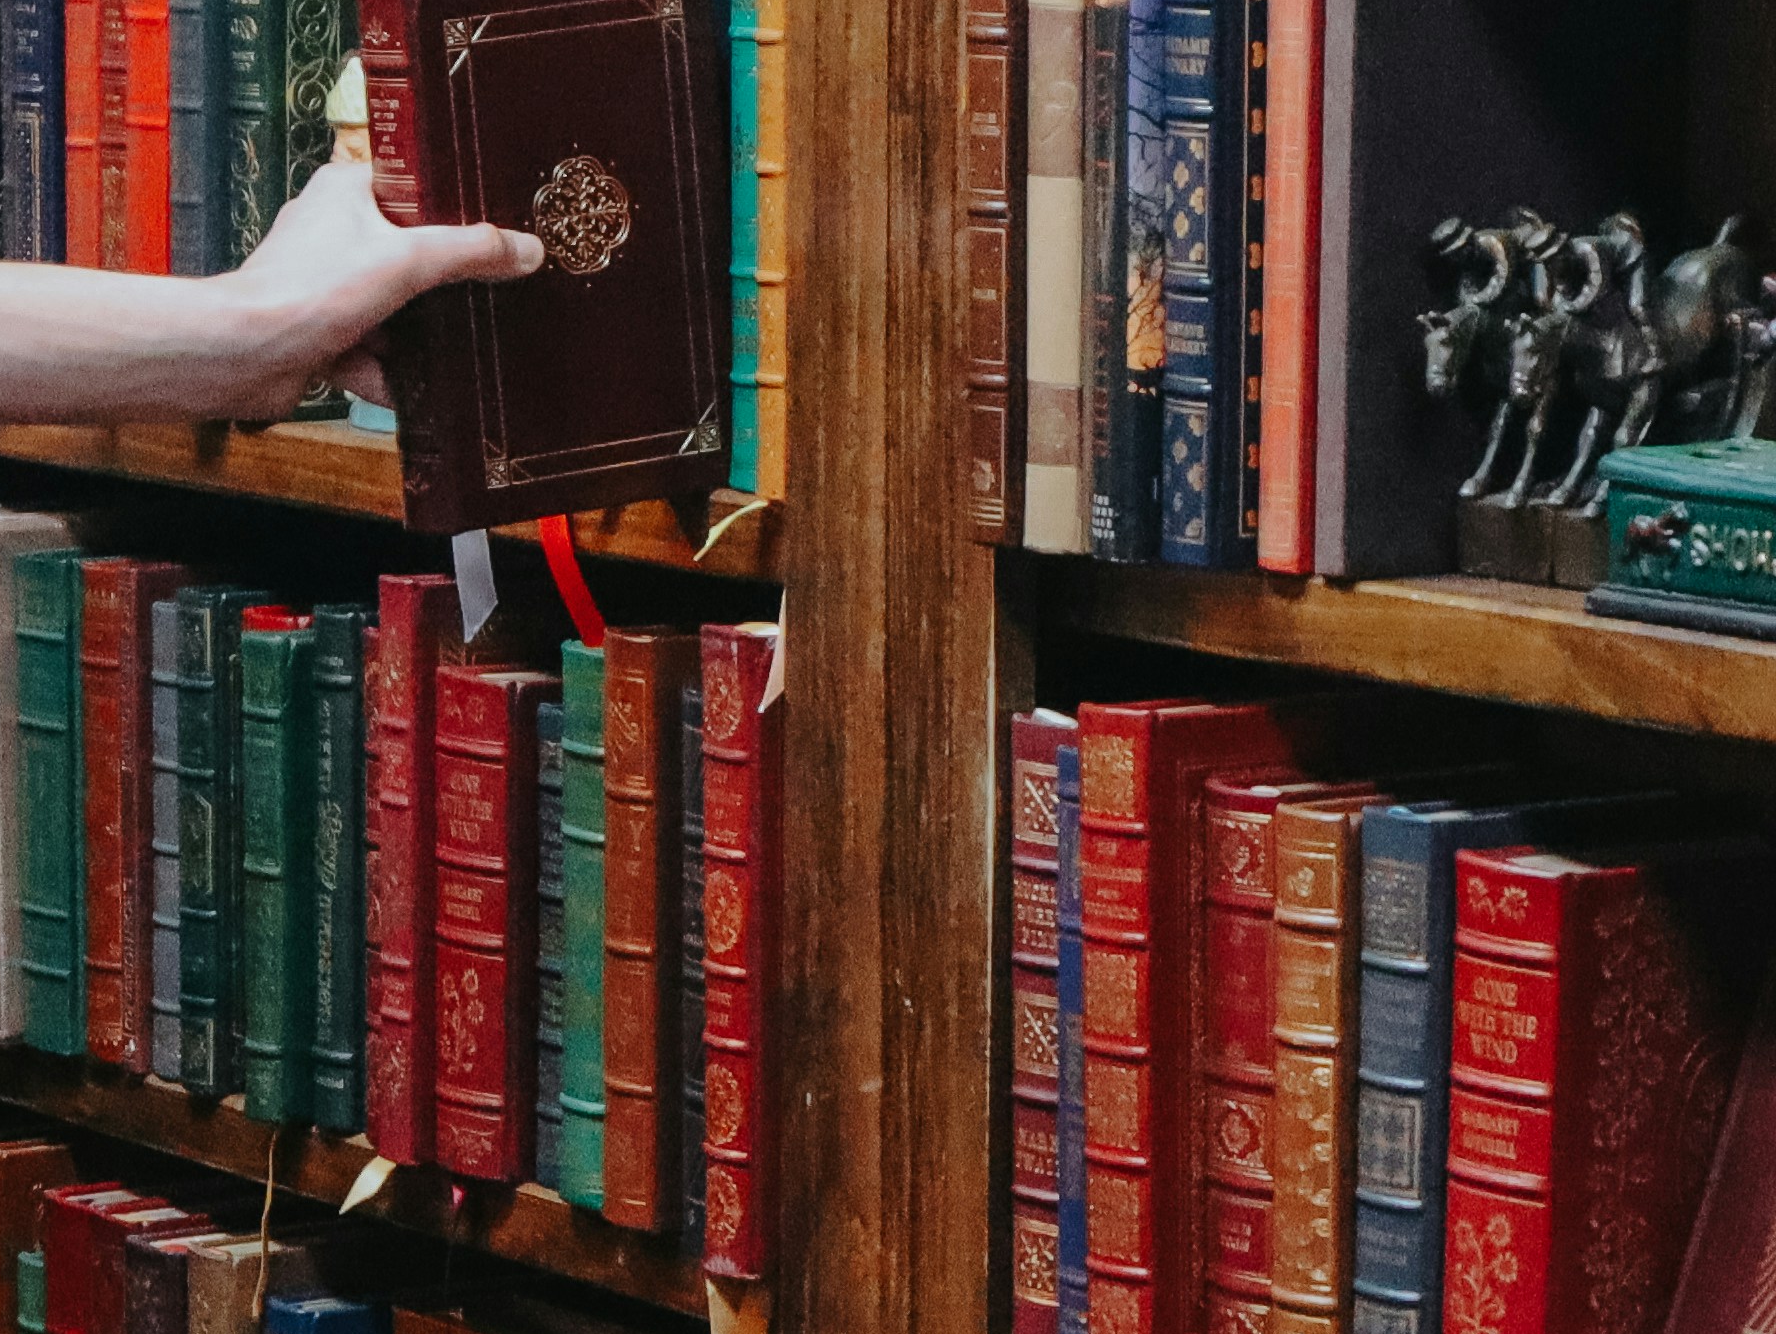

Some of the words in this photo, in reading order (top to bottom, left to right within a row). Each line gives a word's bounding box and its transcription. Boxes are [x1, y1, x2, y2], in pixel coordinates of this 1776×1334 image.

[1473, 975, 1518, 1007] GONE
[1501, 1010, 1539, 1041] THE
[1470, 1032, 1519, 1064] WIND
